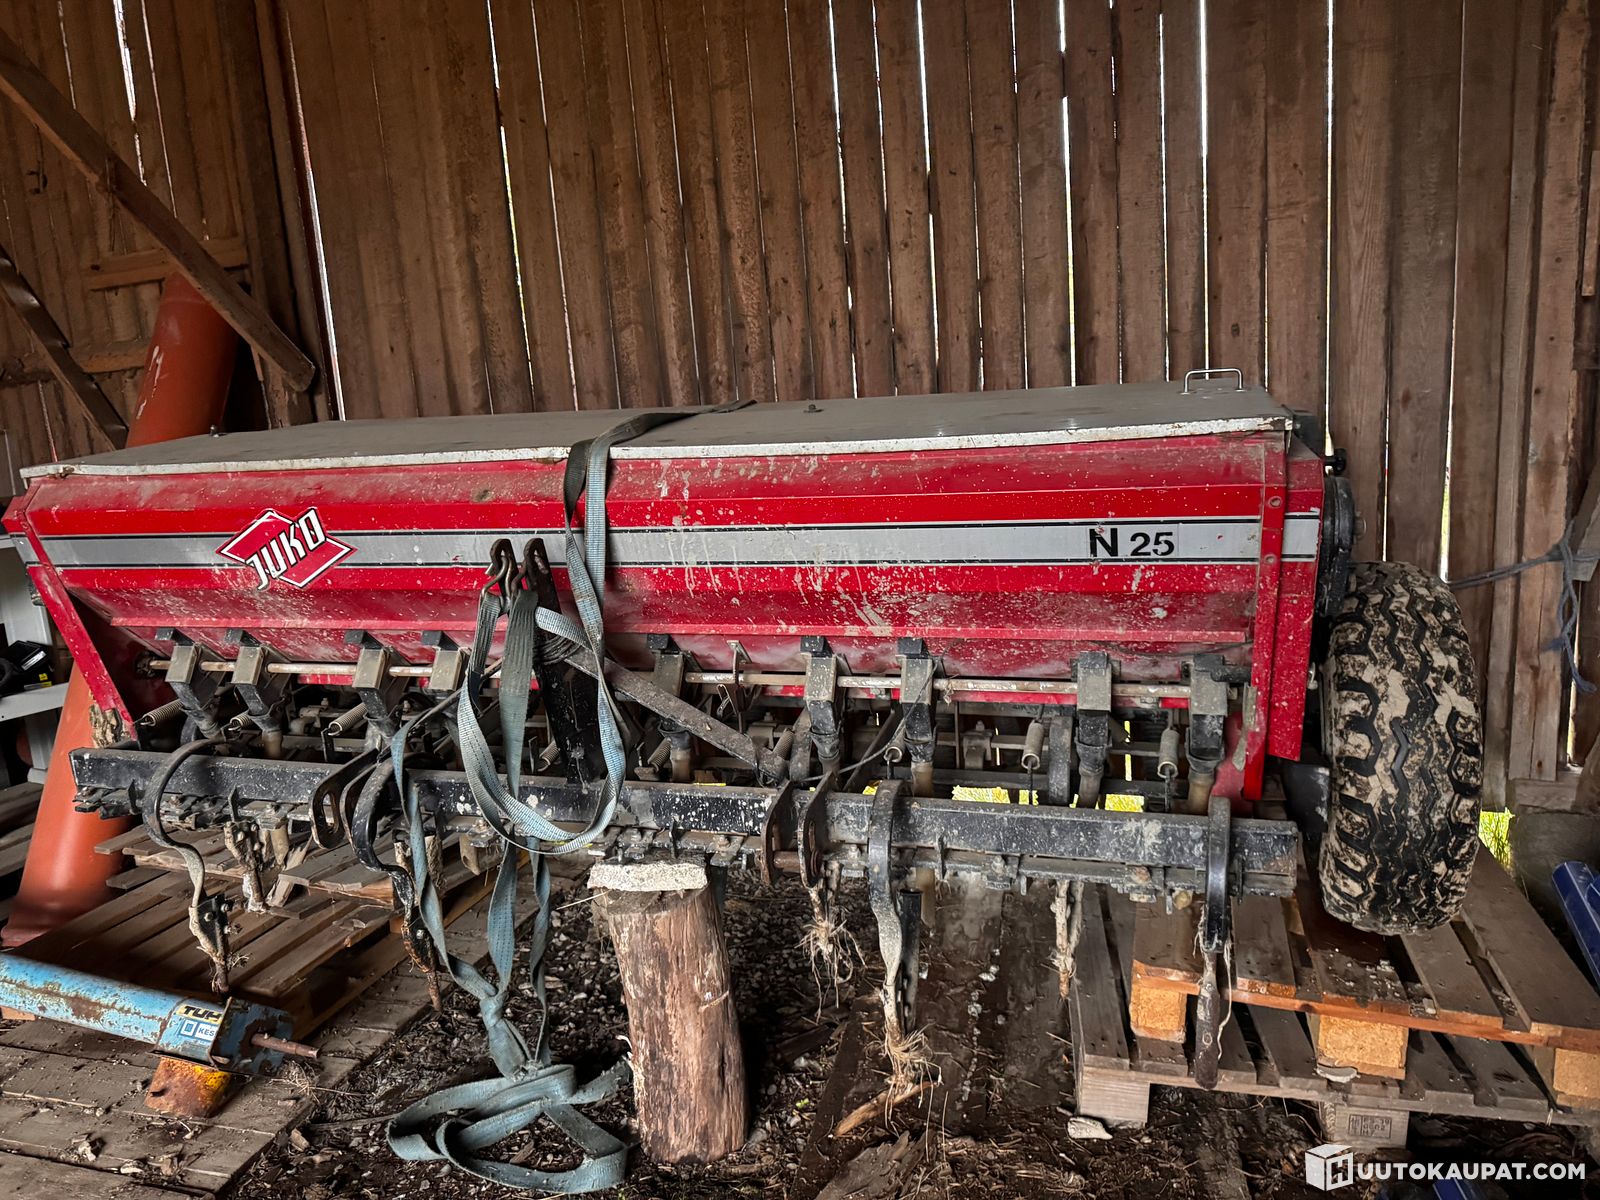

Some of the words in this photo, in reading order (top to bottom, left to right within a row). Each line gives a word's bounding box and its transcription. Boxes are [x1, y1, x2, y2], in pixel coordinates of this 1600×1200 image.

[245, 508, 326, 591] JUKO
[1089, 527, 1119, 558] N
[1130, 532, 1175, 557] 25
[198, 1027, 217, 1038] KES
